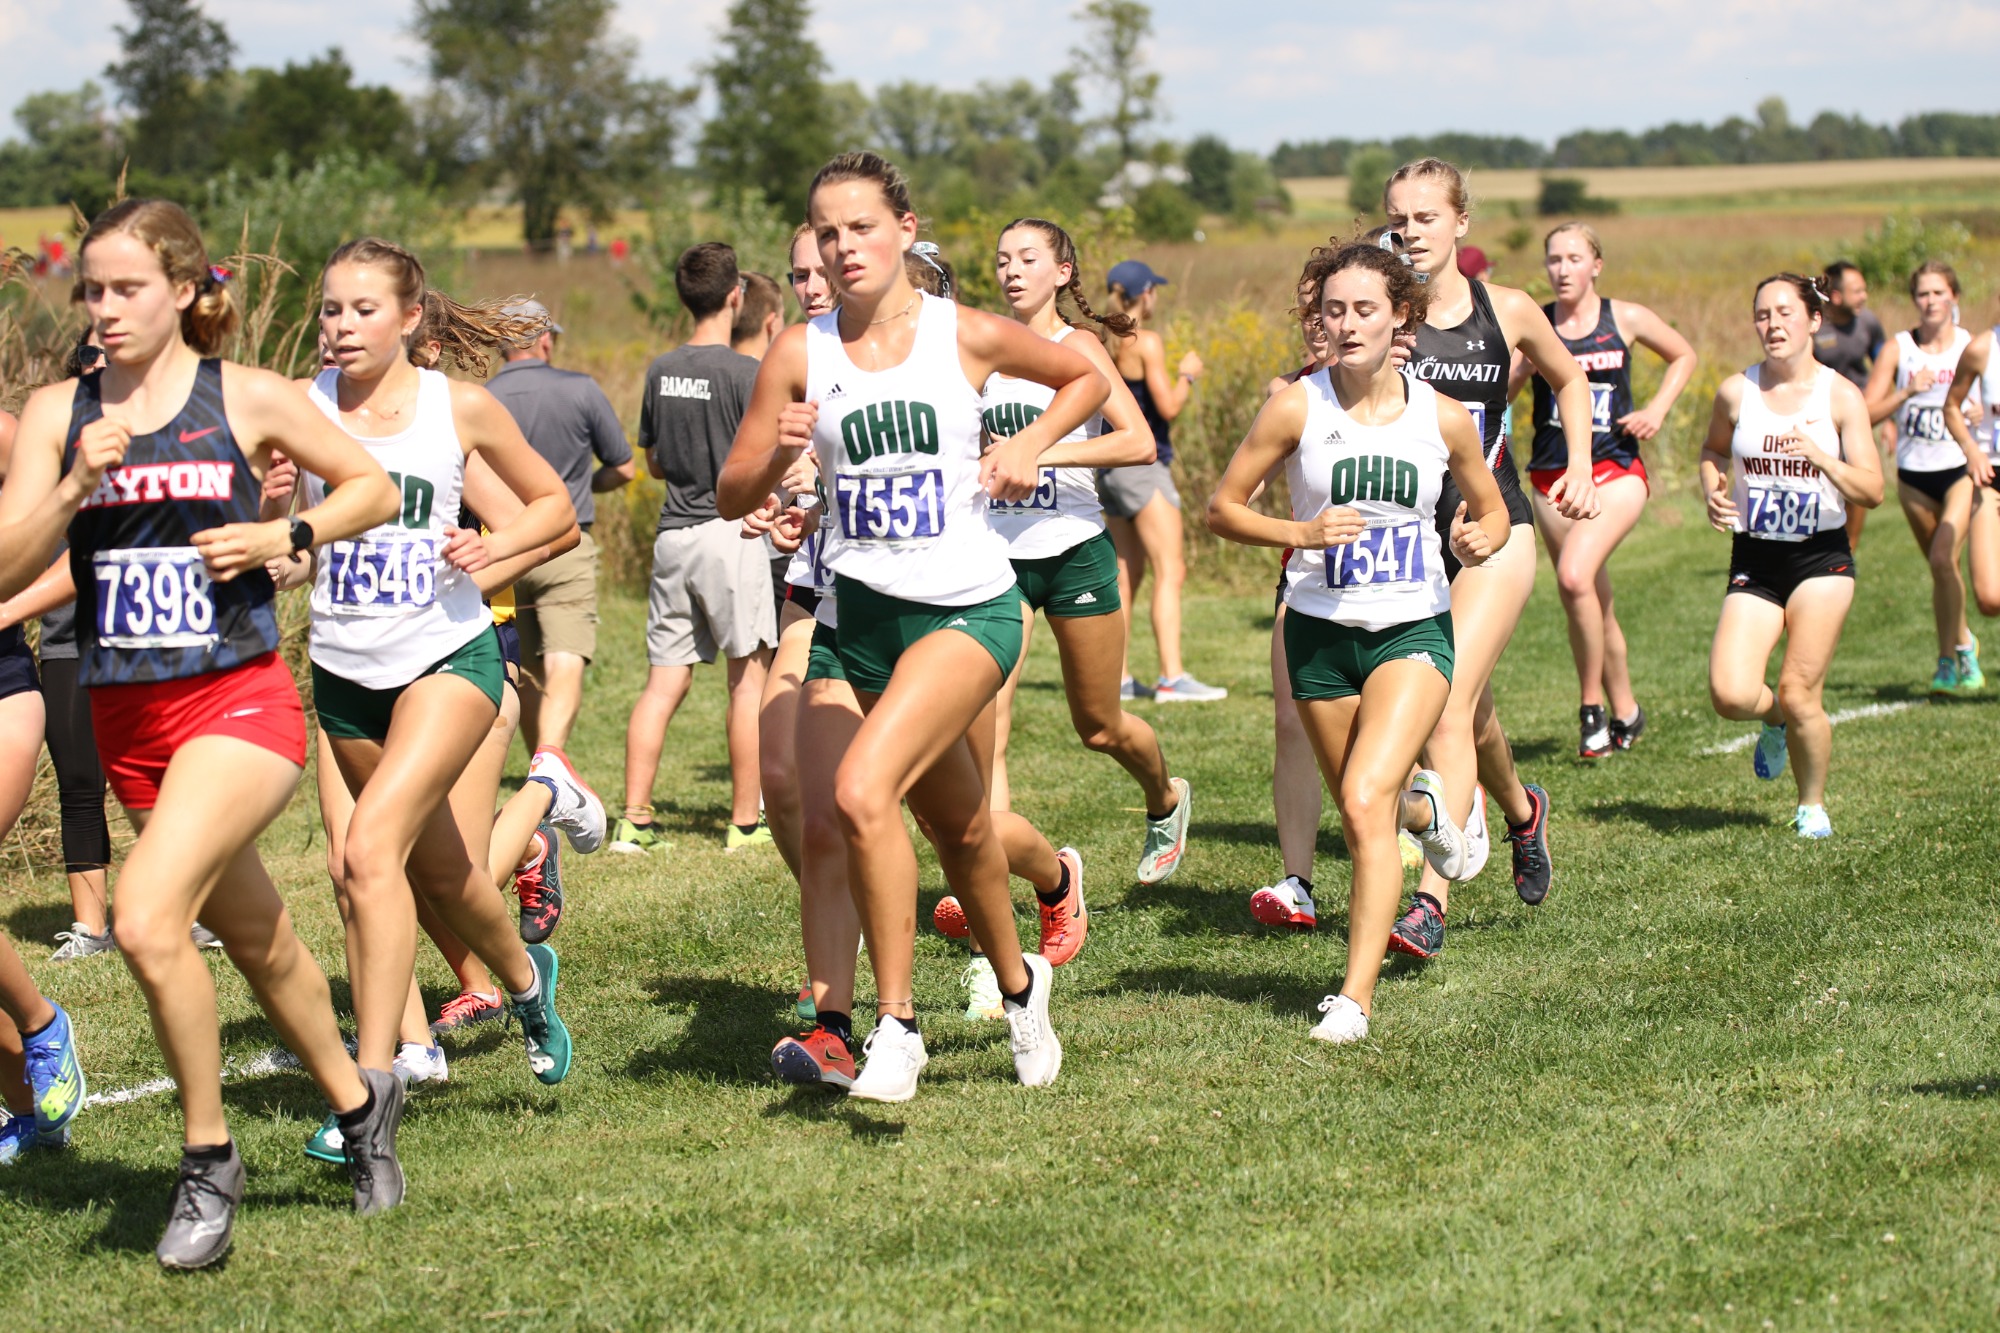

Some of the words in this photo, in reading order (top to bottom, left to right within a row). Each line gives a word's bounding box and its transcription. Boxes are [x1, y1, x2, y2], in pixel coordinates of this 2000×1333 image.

[660, 376, 711, 400] RAMMEL
[1399, 361, 1501, 382] NCINNATI
[841, 400, 939, 465] OHIO
[982, 402, 1046, 444] OHI
[79, 461, 234, 510] AYTON
[838, 471, 940, 539] 7551
[1331, 455, 1418, 508] OHIO
[1748, 489, 1818, 535] 7584
[333, 541, 434, 605] 7546
[1333, 525, 1419, 586] 7547
[95, 562, 213, 636] 7398
